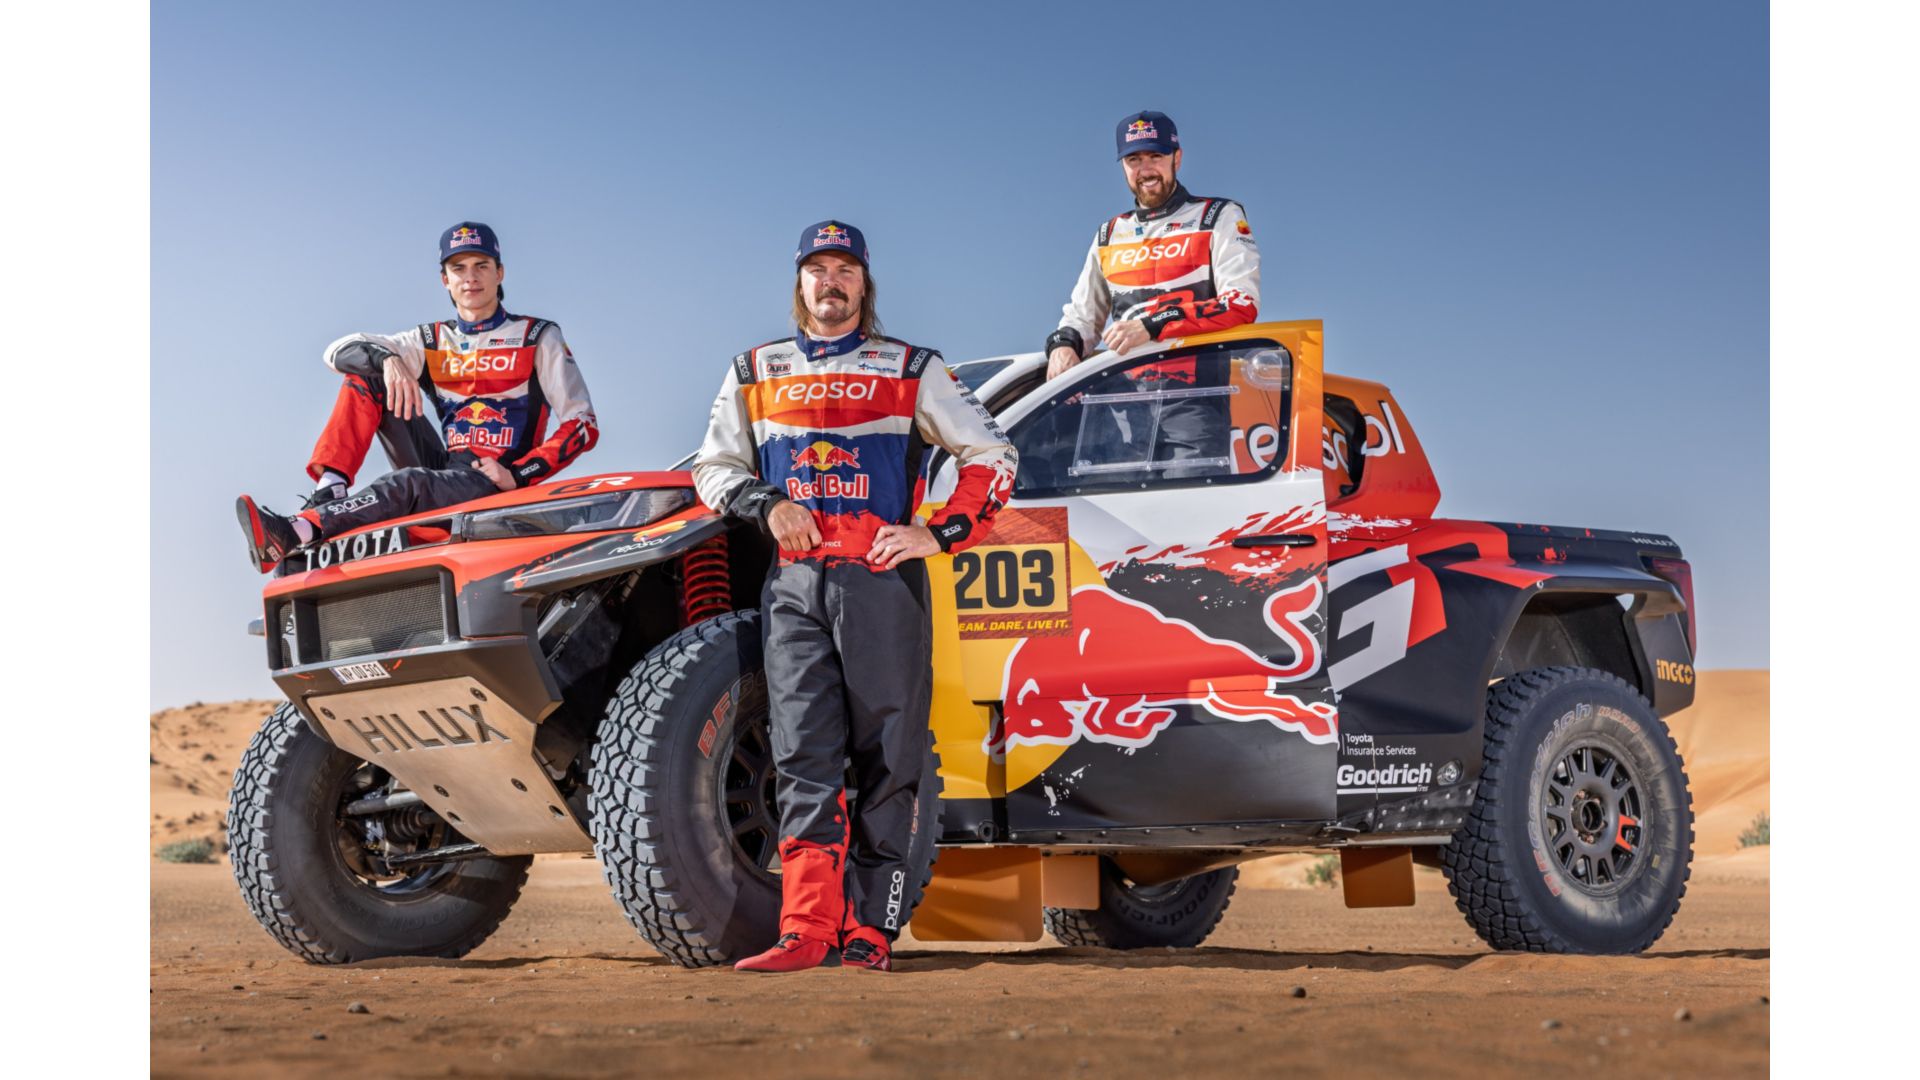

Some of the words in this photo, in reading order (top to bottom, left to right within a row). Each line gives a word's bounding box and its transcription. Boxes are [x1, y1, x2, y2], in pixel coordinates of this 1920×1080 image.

[813, 236, 832, 247] Red
[833, 236, 851, 247] Bull
[1110, 238, 1190, 267] repsol
[441, 351, 518, 377] repsol
[774, 380, 877, 405] repsol
[447, 426, 475, 447] Red
[475, 427, 513, 447] Bull
[548, 476, 634, 495] GR
[786, 473, 823, 503] Red
[824, 473, 869, 499] Bull
[327, 495, 379, 515] sparco
[304, 526, 402, 571] TOYOTA
[953, 549, 1055, 609] 203
[989, 620, 1024, 631] DARE.
[1027, 620, 1053, 629] LIVE
[1054, 619, 1069, 628] IT.
[344, 703, 512, 754] HILUX
[1345, 733, 1373, 745] Toyota
[1347, 746, 1384, 756] Insurance
[1385, 745, 1416, 756] Services
[1336, 763, 1433, 786] Goodrich
